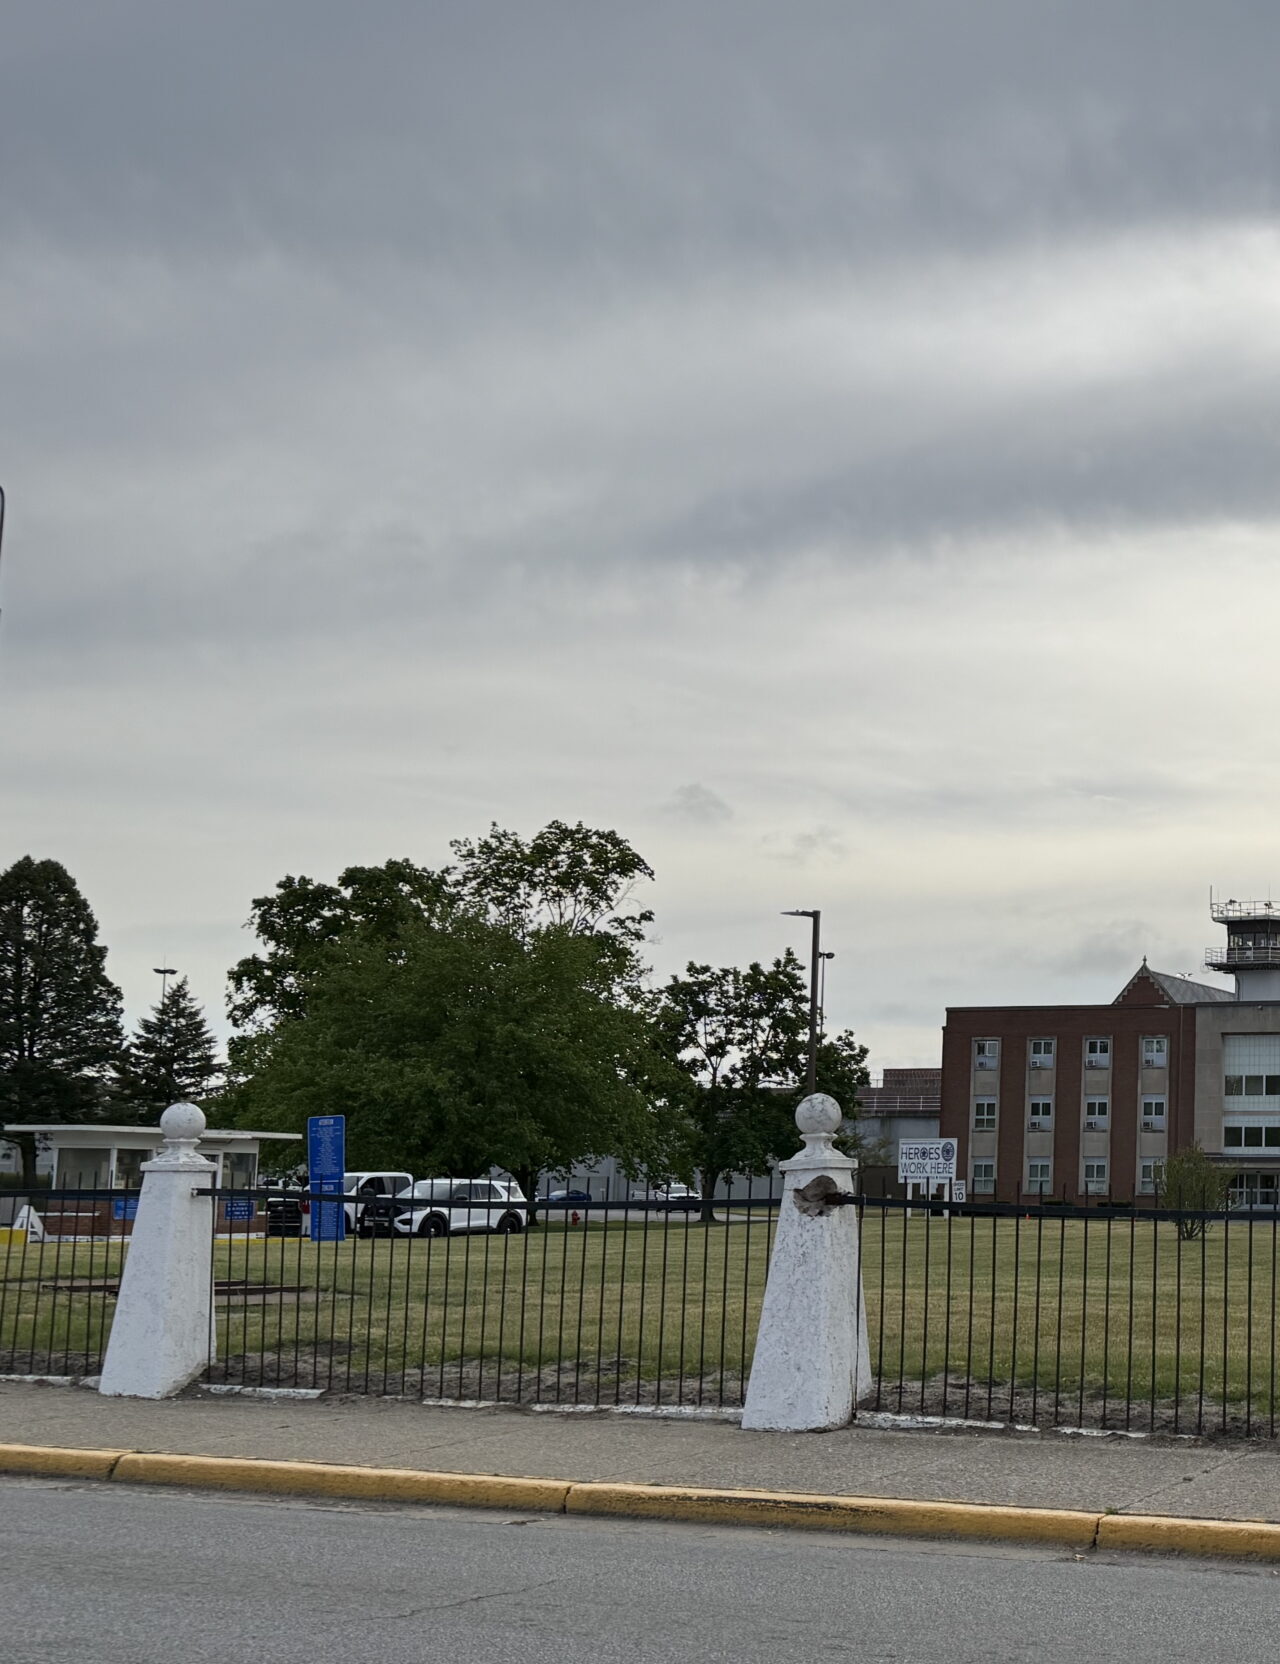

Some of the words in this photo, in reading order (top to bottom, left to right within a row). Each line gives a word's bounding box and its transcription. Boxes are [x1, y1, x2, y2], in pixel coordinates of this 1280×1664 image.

[901, 1147, 940, 1160] HEROES
[901, 1162, 928, 1174] WORK
[930, 1162, 954, 1174] HERE
[954, 1191, 964, 1201] 10
